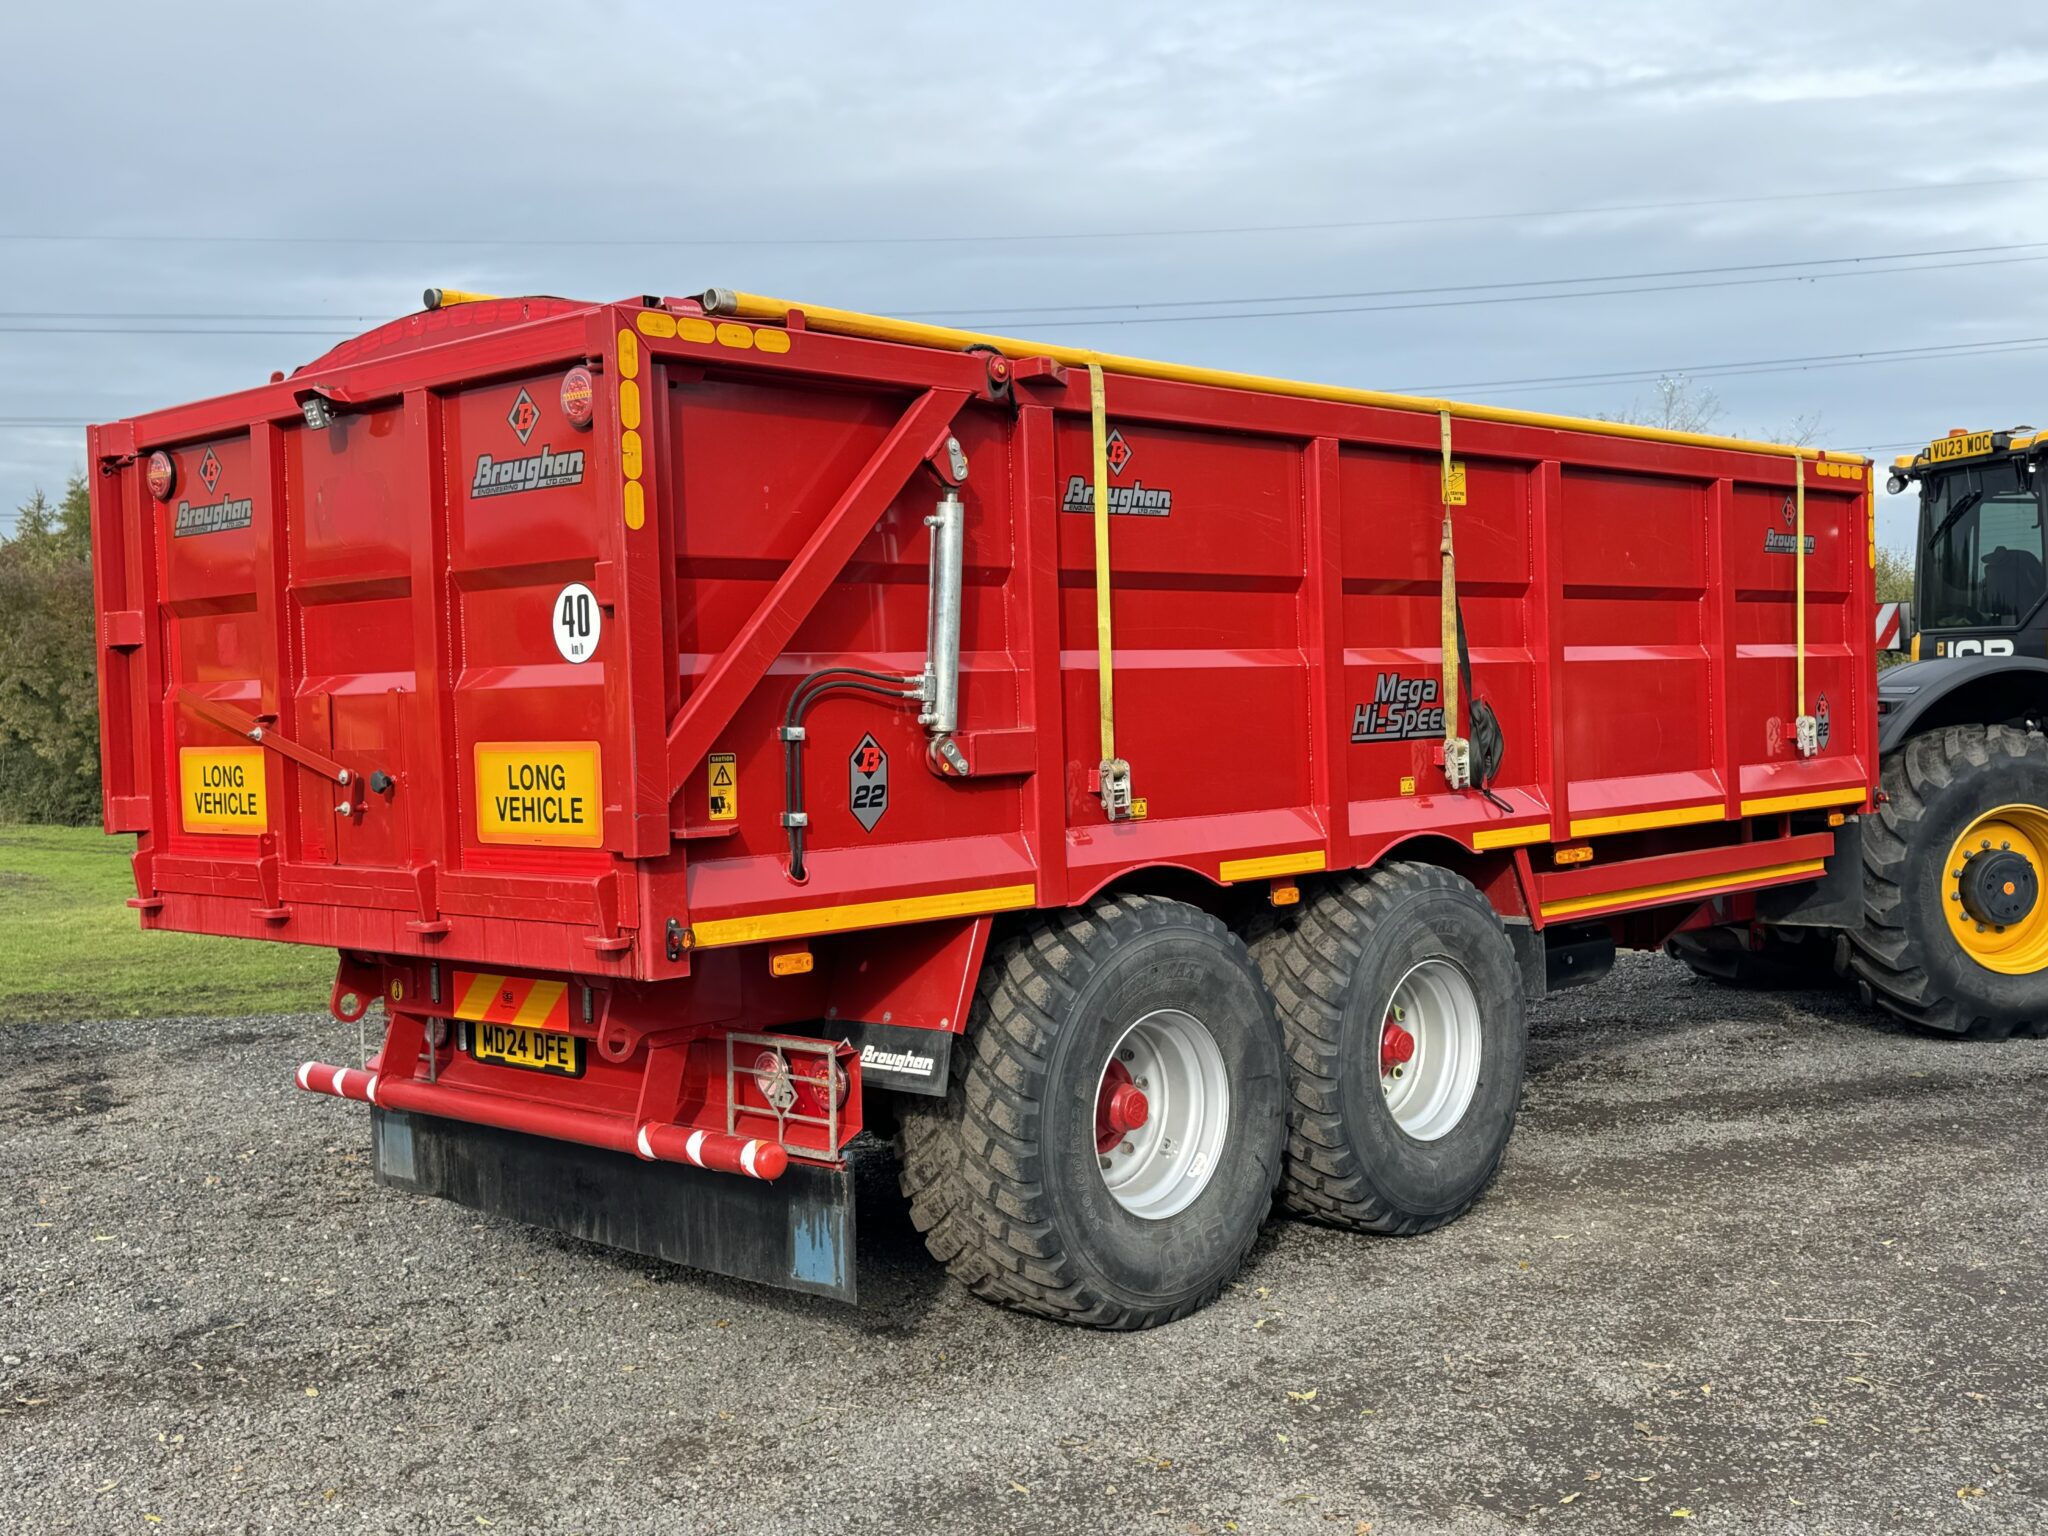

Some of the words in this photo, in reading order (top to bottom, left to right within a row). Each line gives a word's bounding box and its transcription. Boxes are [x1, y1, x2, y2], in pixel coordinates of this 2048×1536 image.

[1933, 439, 1963, 459] VU23
[1967, 435, 1990, 453] WOC
[473, 446, 584, 489] Broughan
[1064, 477, 1171, 514] Brughan
[175, 495, 251, 531] Broughan
[562, 594, 591, 638] 40
[1374, 673, 1438, 708] Mega
[1817, 722, 1829, 737] 22
[203, 765, 245, 788] LONG
[508, 764, 566, 791] LONG
[194, 792, 257, 816] VEHICLE
[495, 796, 584, 824] VEHICLE
[852, 784, 886, 809] 22
[483, 1024, 528, 1058] MD24
[534, 1032, 569, 1065] DFE
[860, 1044, 935, 1072] Broughan
